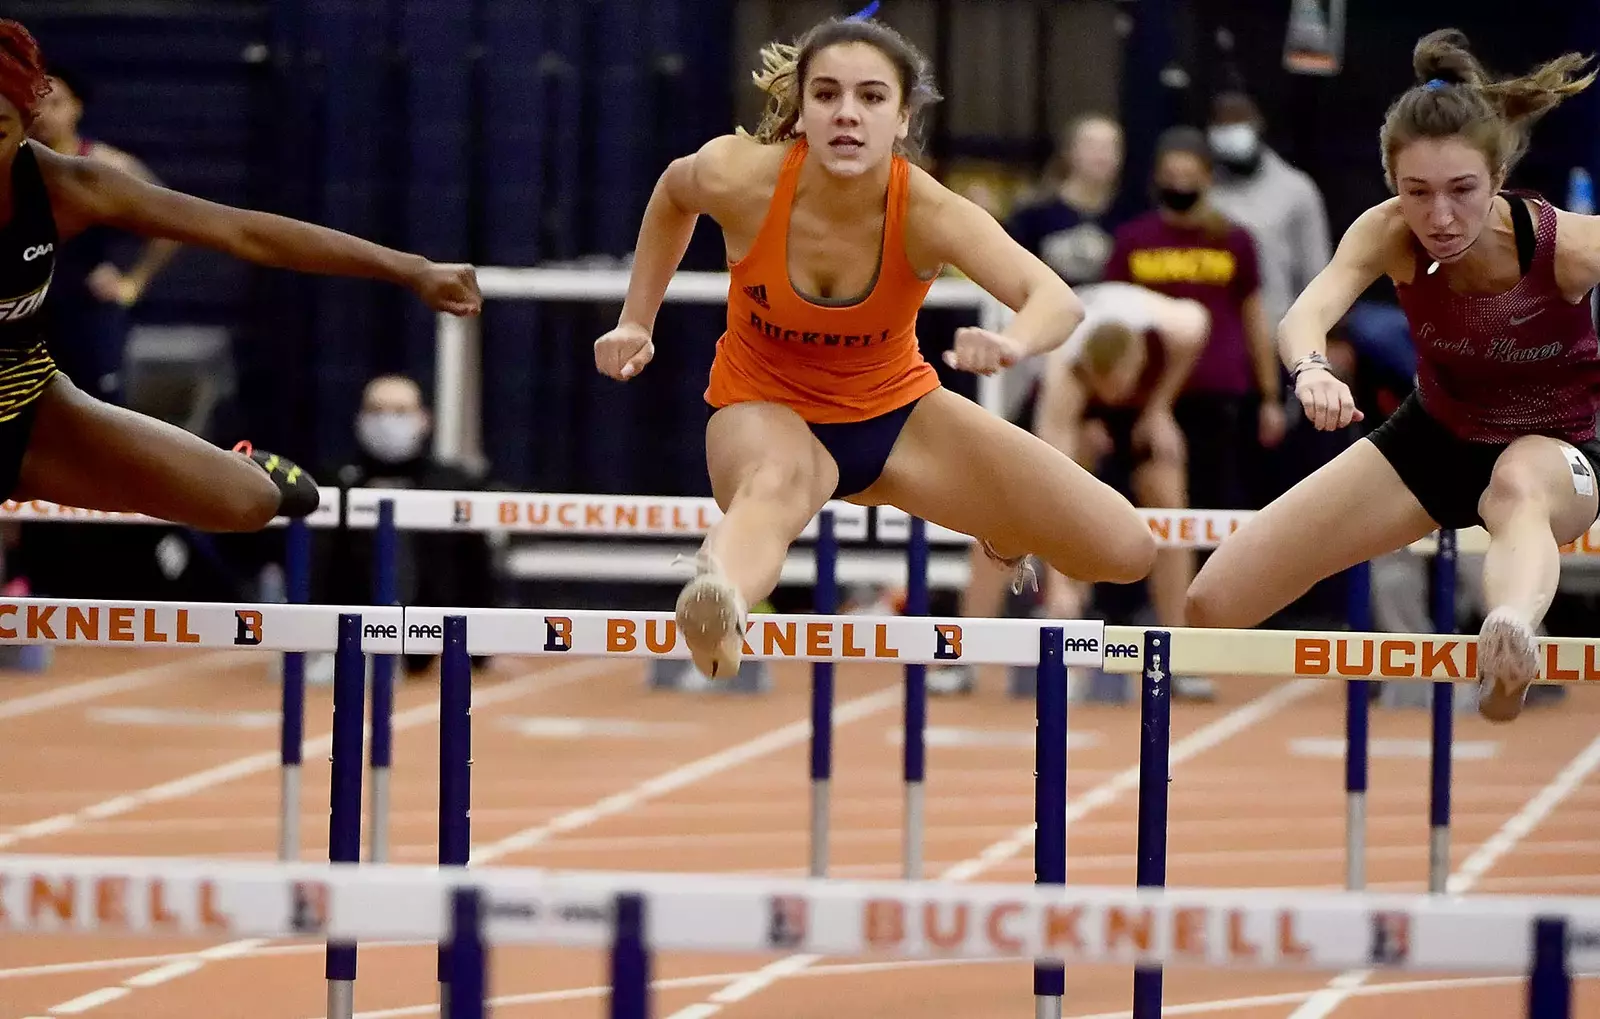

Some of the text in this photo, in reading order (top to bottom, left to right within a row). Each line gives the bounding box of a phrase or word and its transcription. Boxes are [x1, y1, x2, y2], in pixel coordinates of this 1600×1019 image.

[23, 242, 54, 261] CAA
[1485, 337, 1563, 364] Haven
[498, 501, 713, 530] BUCKNELL
[234, 610, 263, 645] B
[543, 616, 573, 652] B
[606, 619, 899, 658] BUNELL
[933, 624, 963, 659] B
[1295, 638, 1600, 681] BUCKLL
[0, 873, 232, 930] NELL
[861, 899, 1311, 957] BUCKNELL
